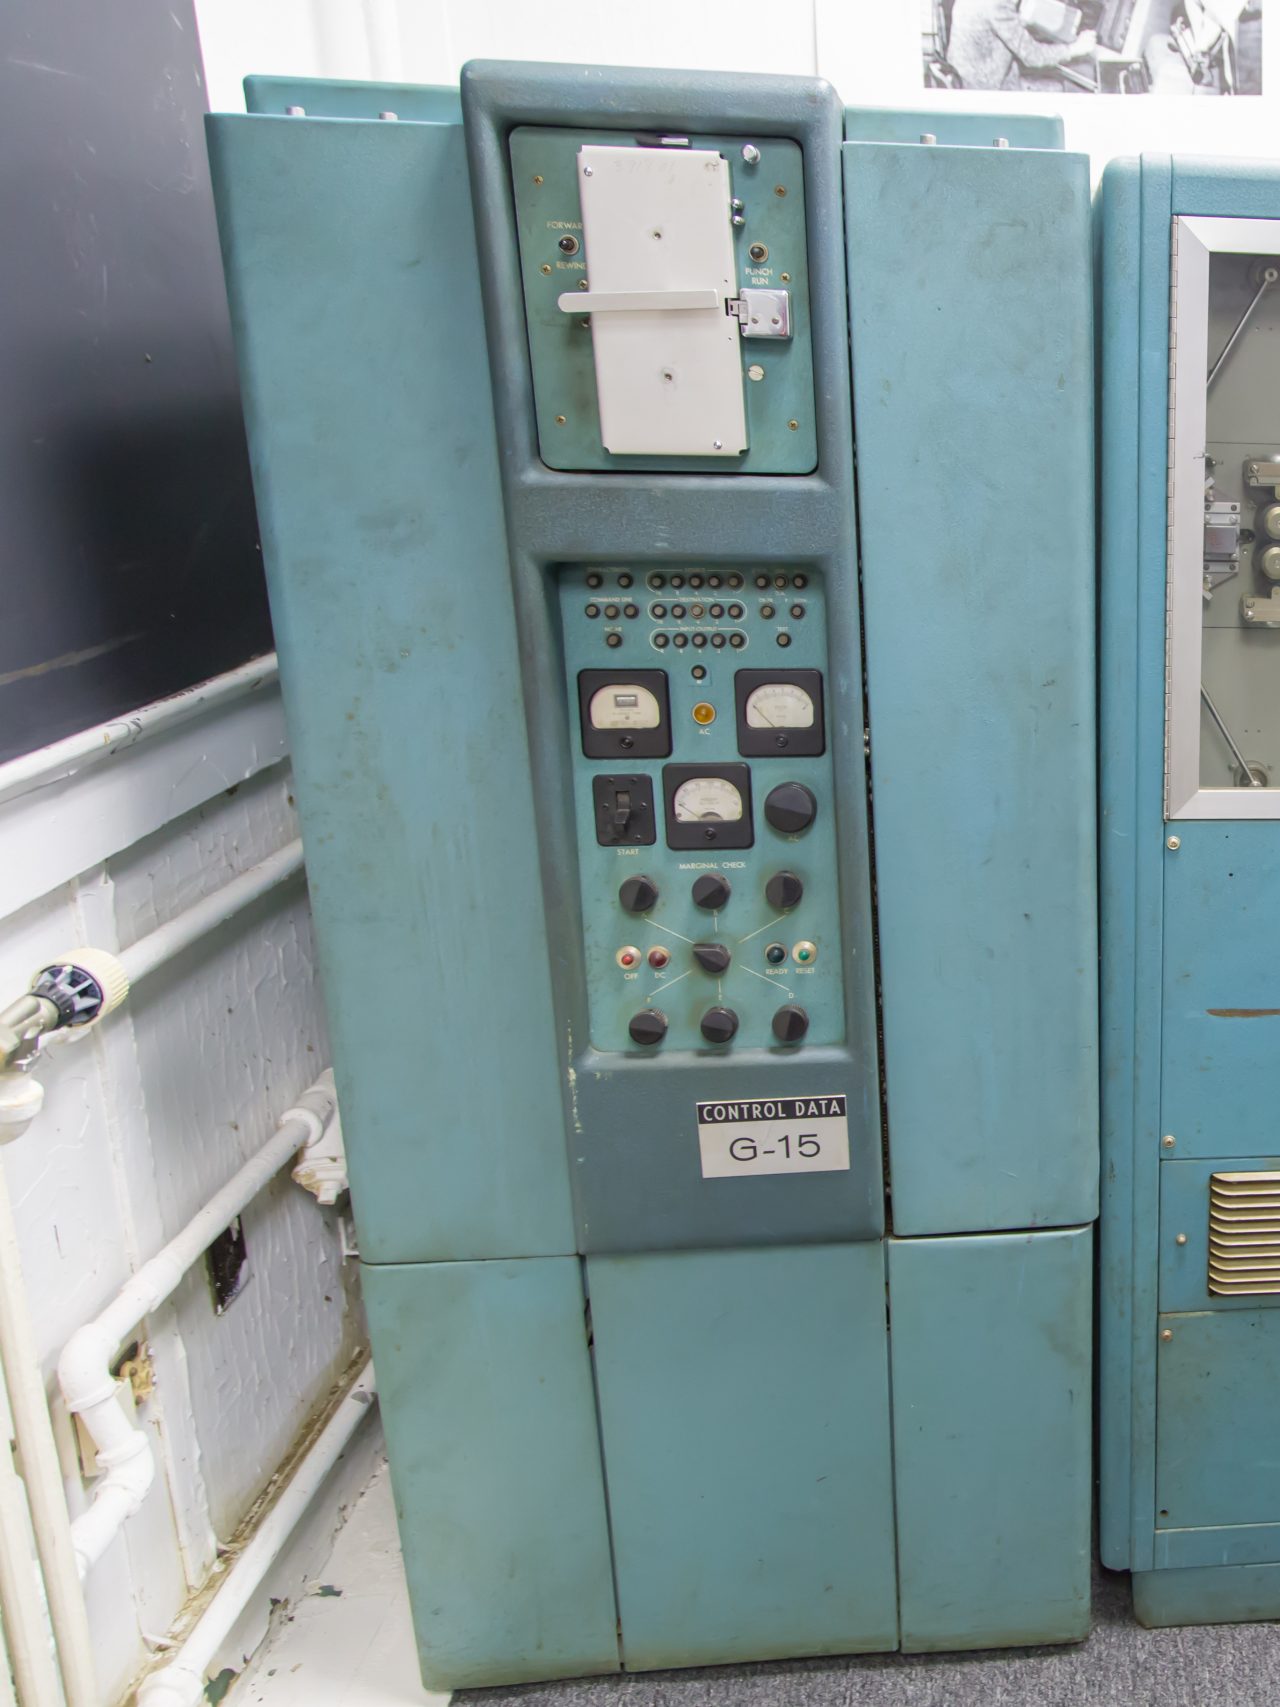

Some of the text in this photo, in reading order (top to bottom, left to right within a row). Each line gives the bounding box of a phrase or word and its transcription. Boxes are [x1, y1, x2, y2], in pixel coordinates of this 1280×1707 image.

[547, 221, 582, 230] FORWAR
[745, 267, 773, 276] PUNCH
[751, 276, 769, 285] RUN
[616, 848, 640, 856] START
[678, 862, 718, 870] MARGINAL
[765, 968, 788, 976] READY
[703, 1100, 841, 1121] CONTROL DATA
[729, 1133, 821, 1162] G-15
